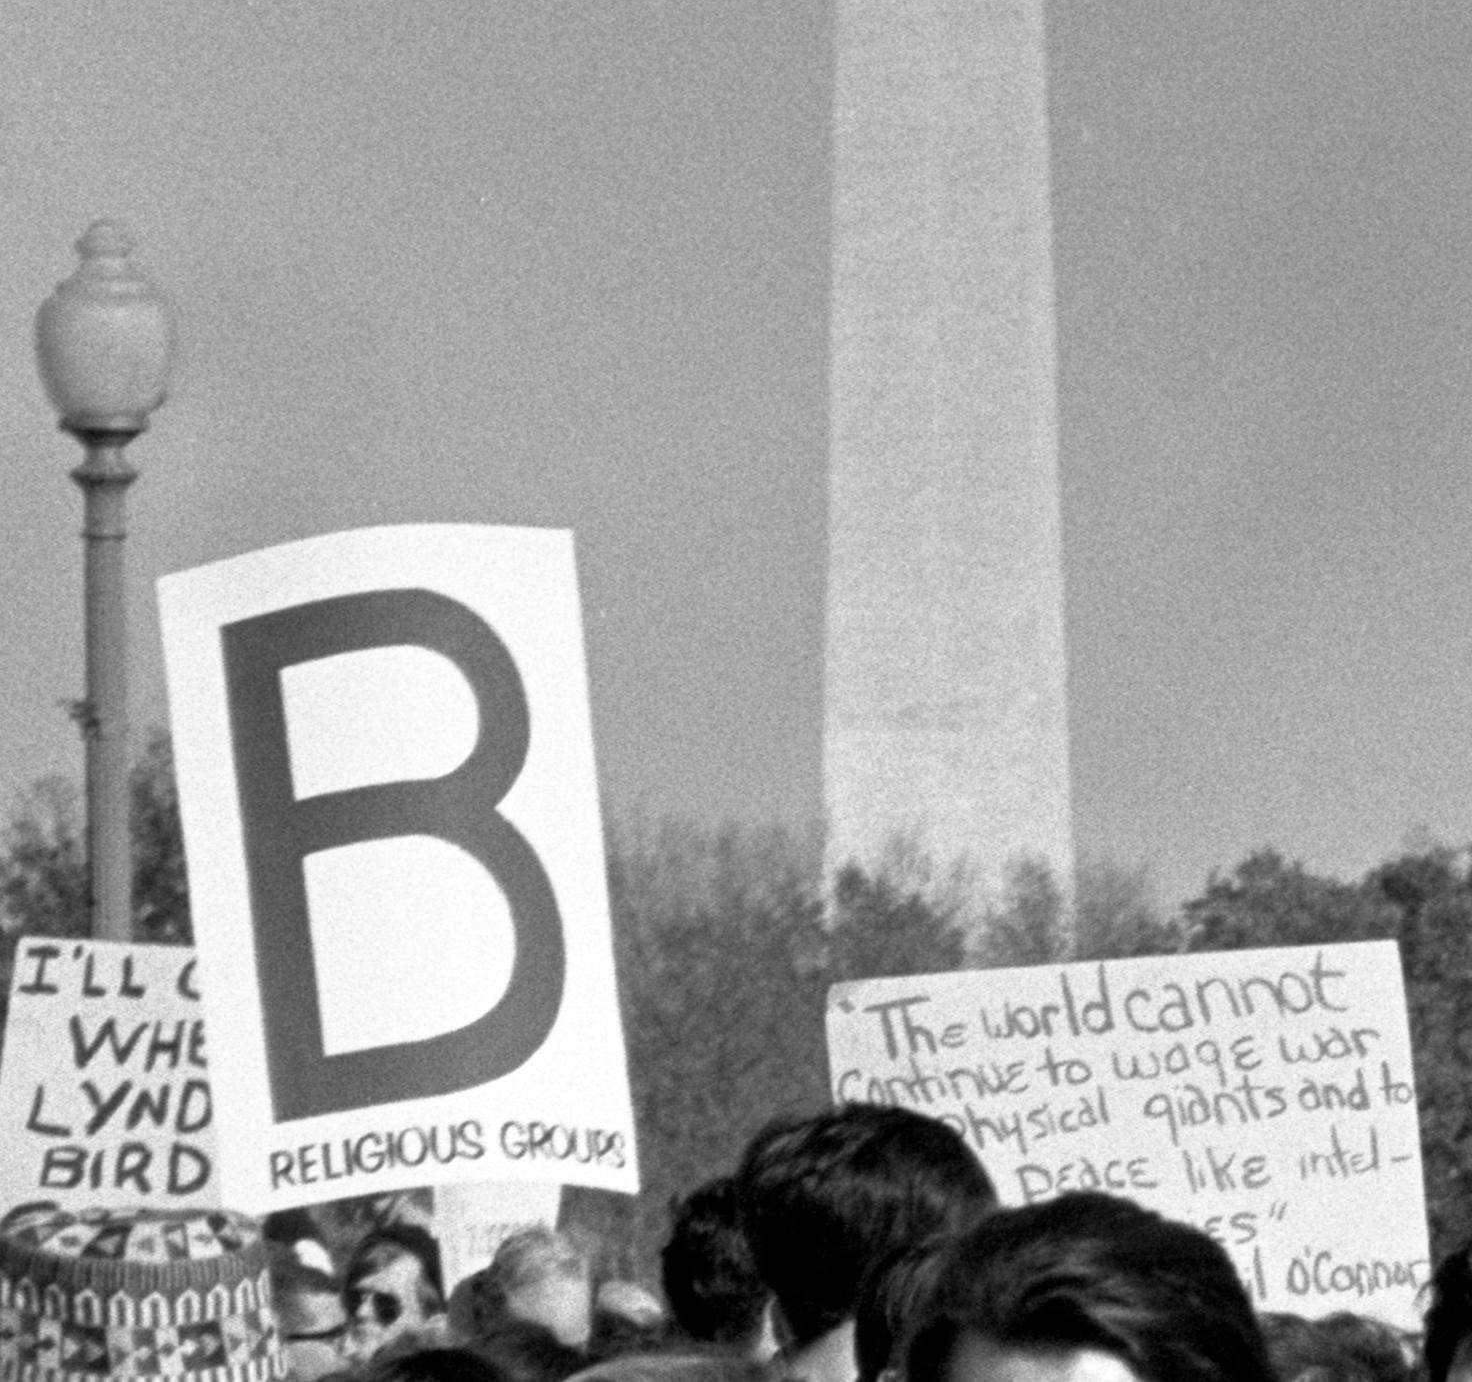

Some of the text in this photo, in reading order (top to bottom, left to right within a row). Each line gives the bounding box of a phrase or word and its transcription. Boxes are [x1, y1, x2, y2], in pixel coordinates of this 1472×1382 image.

[219, 586, 567, 1125] B
[17, 944, 147, 1001] I'LL
[980, 963, 1114, 1039] world
[1123, 950, 1349, 1033] cannot
[67, 1013, 209, 1072] WHE
[1036, 1047, 1093, 1086] to
[1111, 1035, 1264, 1089] wage
[1278, 1027, 1381, 1064] war
[24, 1075, 214, 1138] LYND
[1143, 1074, 1288, 1148] giants
[1298, 1066, 1371, 1112] and
[1379, 1060, 1413, 1106] to
[39, 1140, 212, 1196] BIRD
[268, 1119, 629, 1191] RELIGIOUS GROUPS
[1183, 1147, 1272, 1194] like
